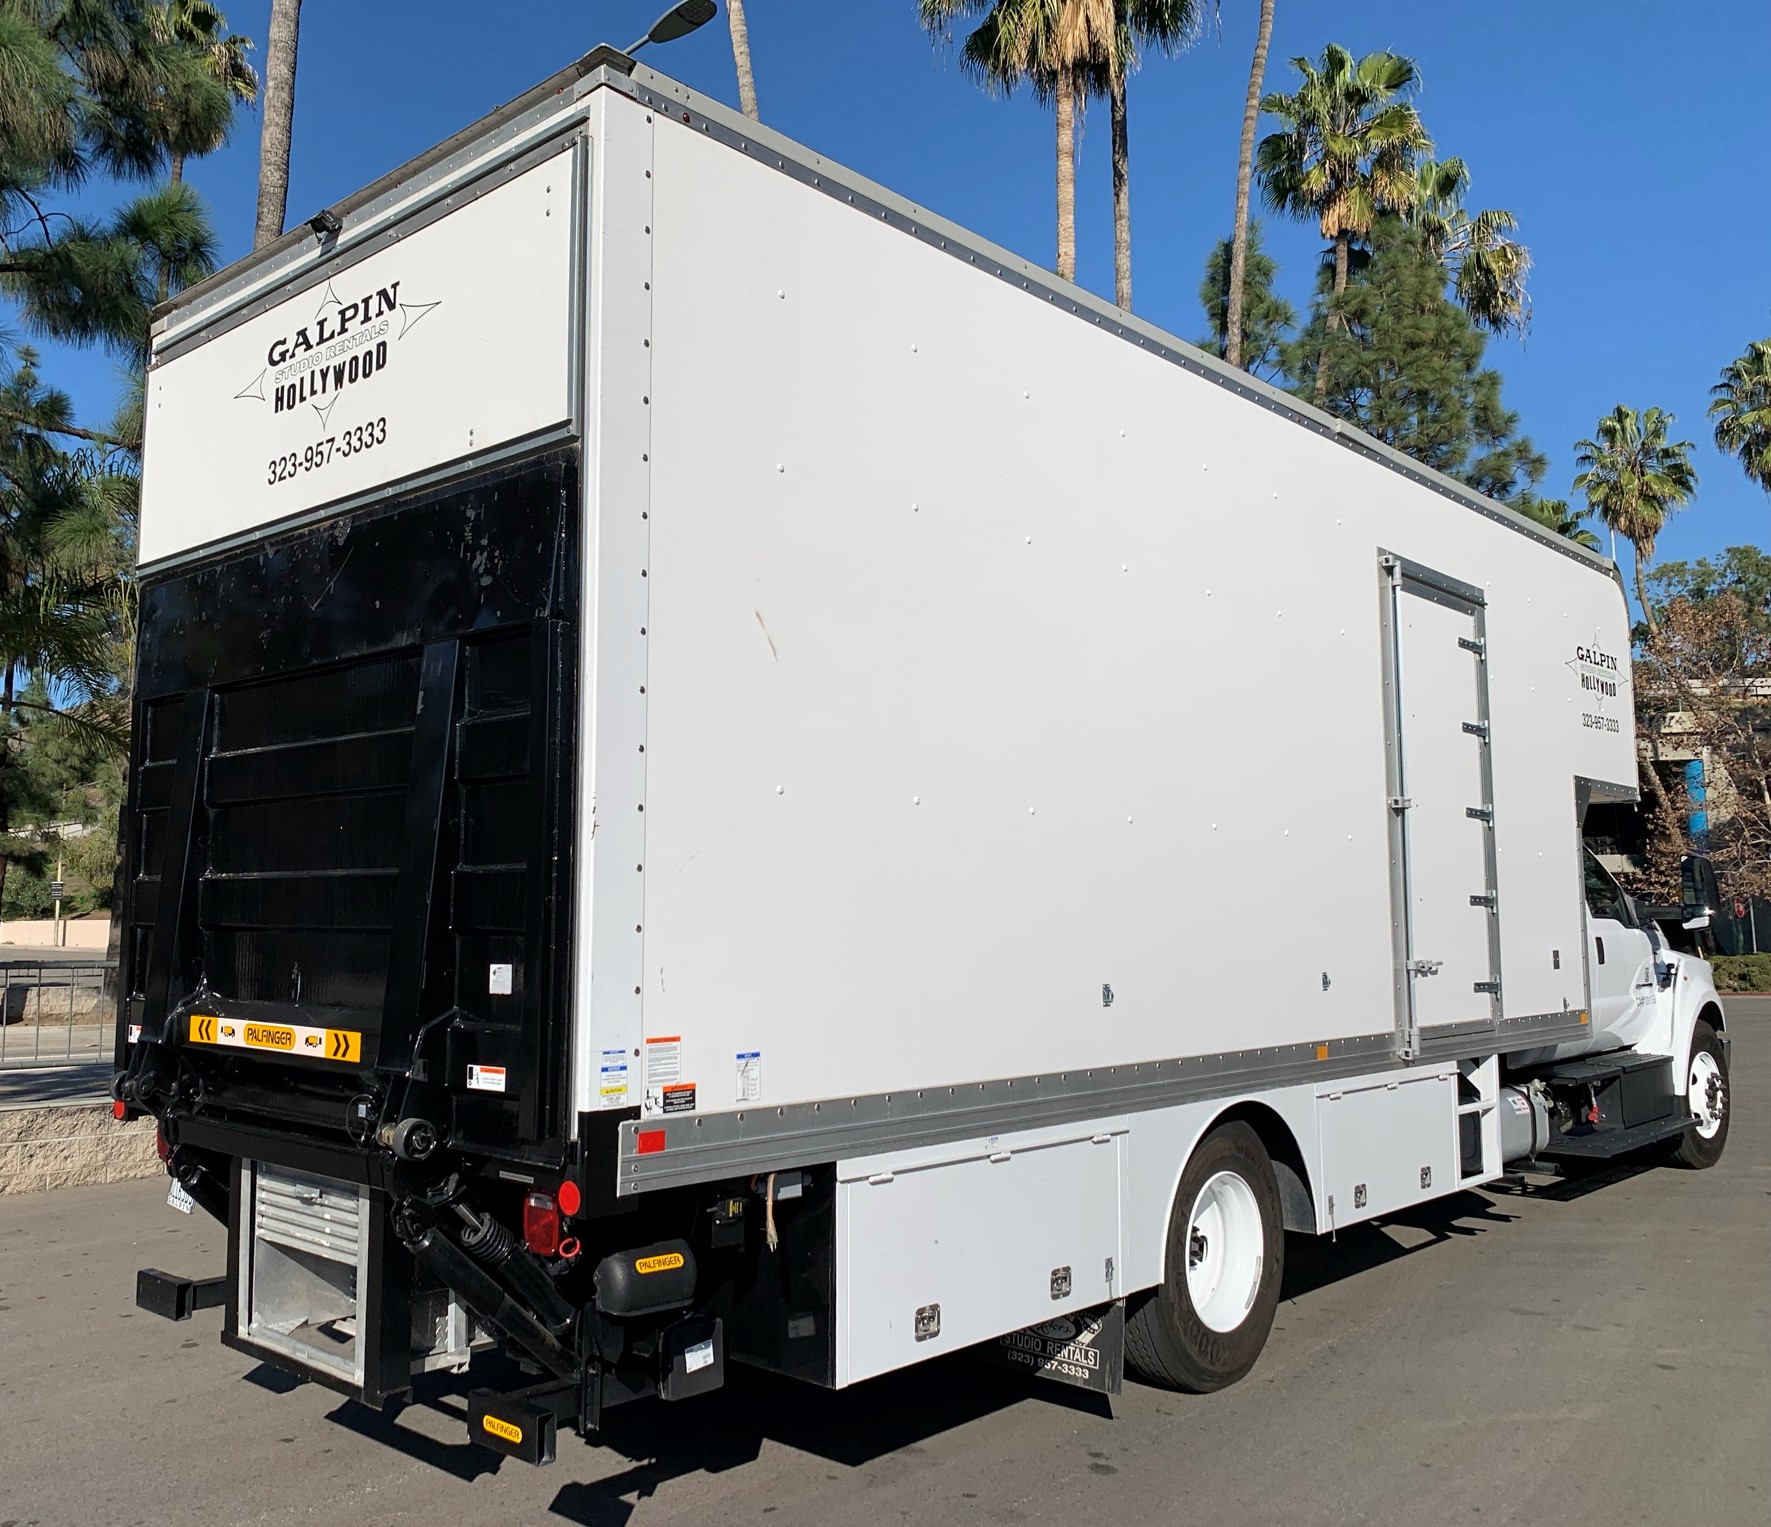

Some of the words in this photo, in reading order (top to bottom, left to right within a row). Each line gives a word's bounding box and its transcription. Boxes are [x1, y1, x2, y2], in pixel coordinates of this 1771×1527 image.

[267, 280, 400, 367] GALPIN
[274, 351, 323, 384] STUDIO
[325, 320, 390, 361] RENTALS
[274, 340, 387, 414] HOLLYWOOD
[267, 416, 387, 485] 323-957-3333
[1576, 645, 1617, 671] GALPIN
[1581, 672, 1617, 697] HOLLYWOOD
[1582, 712, 1620, 733] 323-957-3333
[246, 1027, 292, 1046] PALFINGER
[638, 1255, 682, 1271] PALFINGER
[1004, 1333, 1042, 1352] STUDIO
[1047, 1341, 1095, 1365] RENTALS
[1007, 1350, 1034, 1366] (323)
[1037, 1357, 1090, 1379] 957-3333
[485, 1418, 520, 1440] PALFINGER
